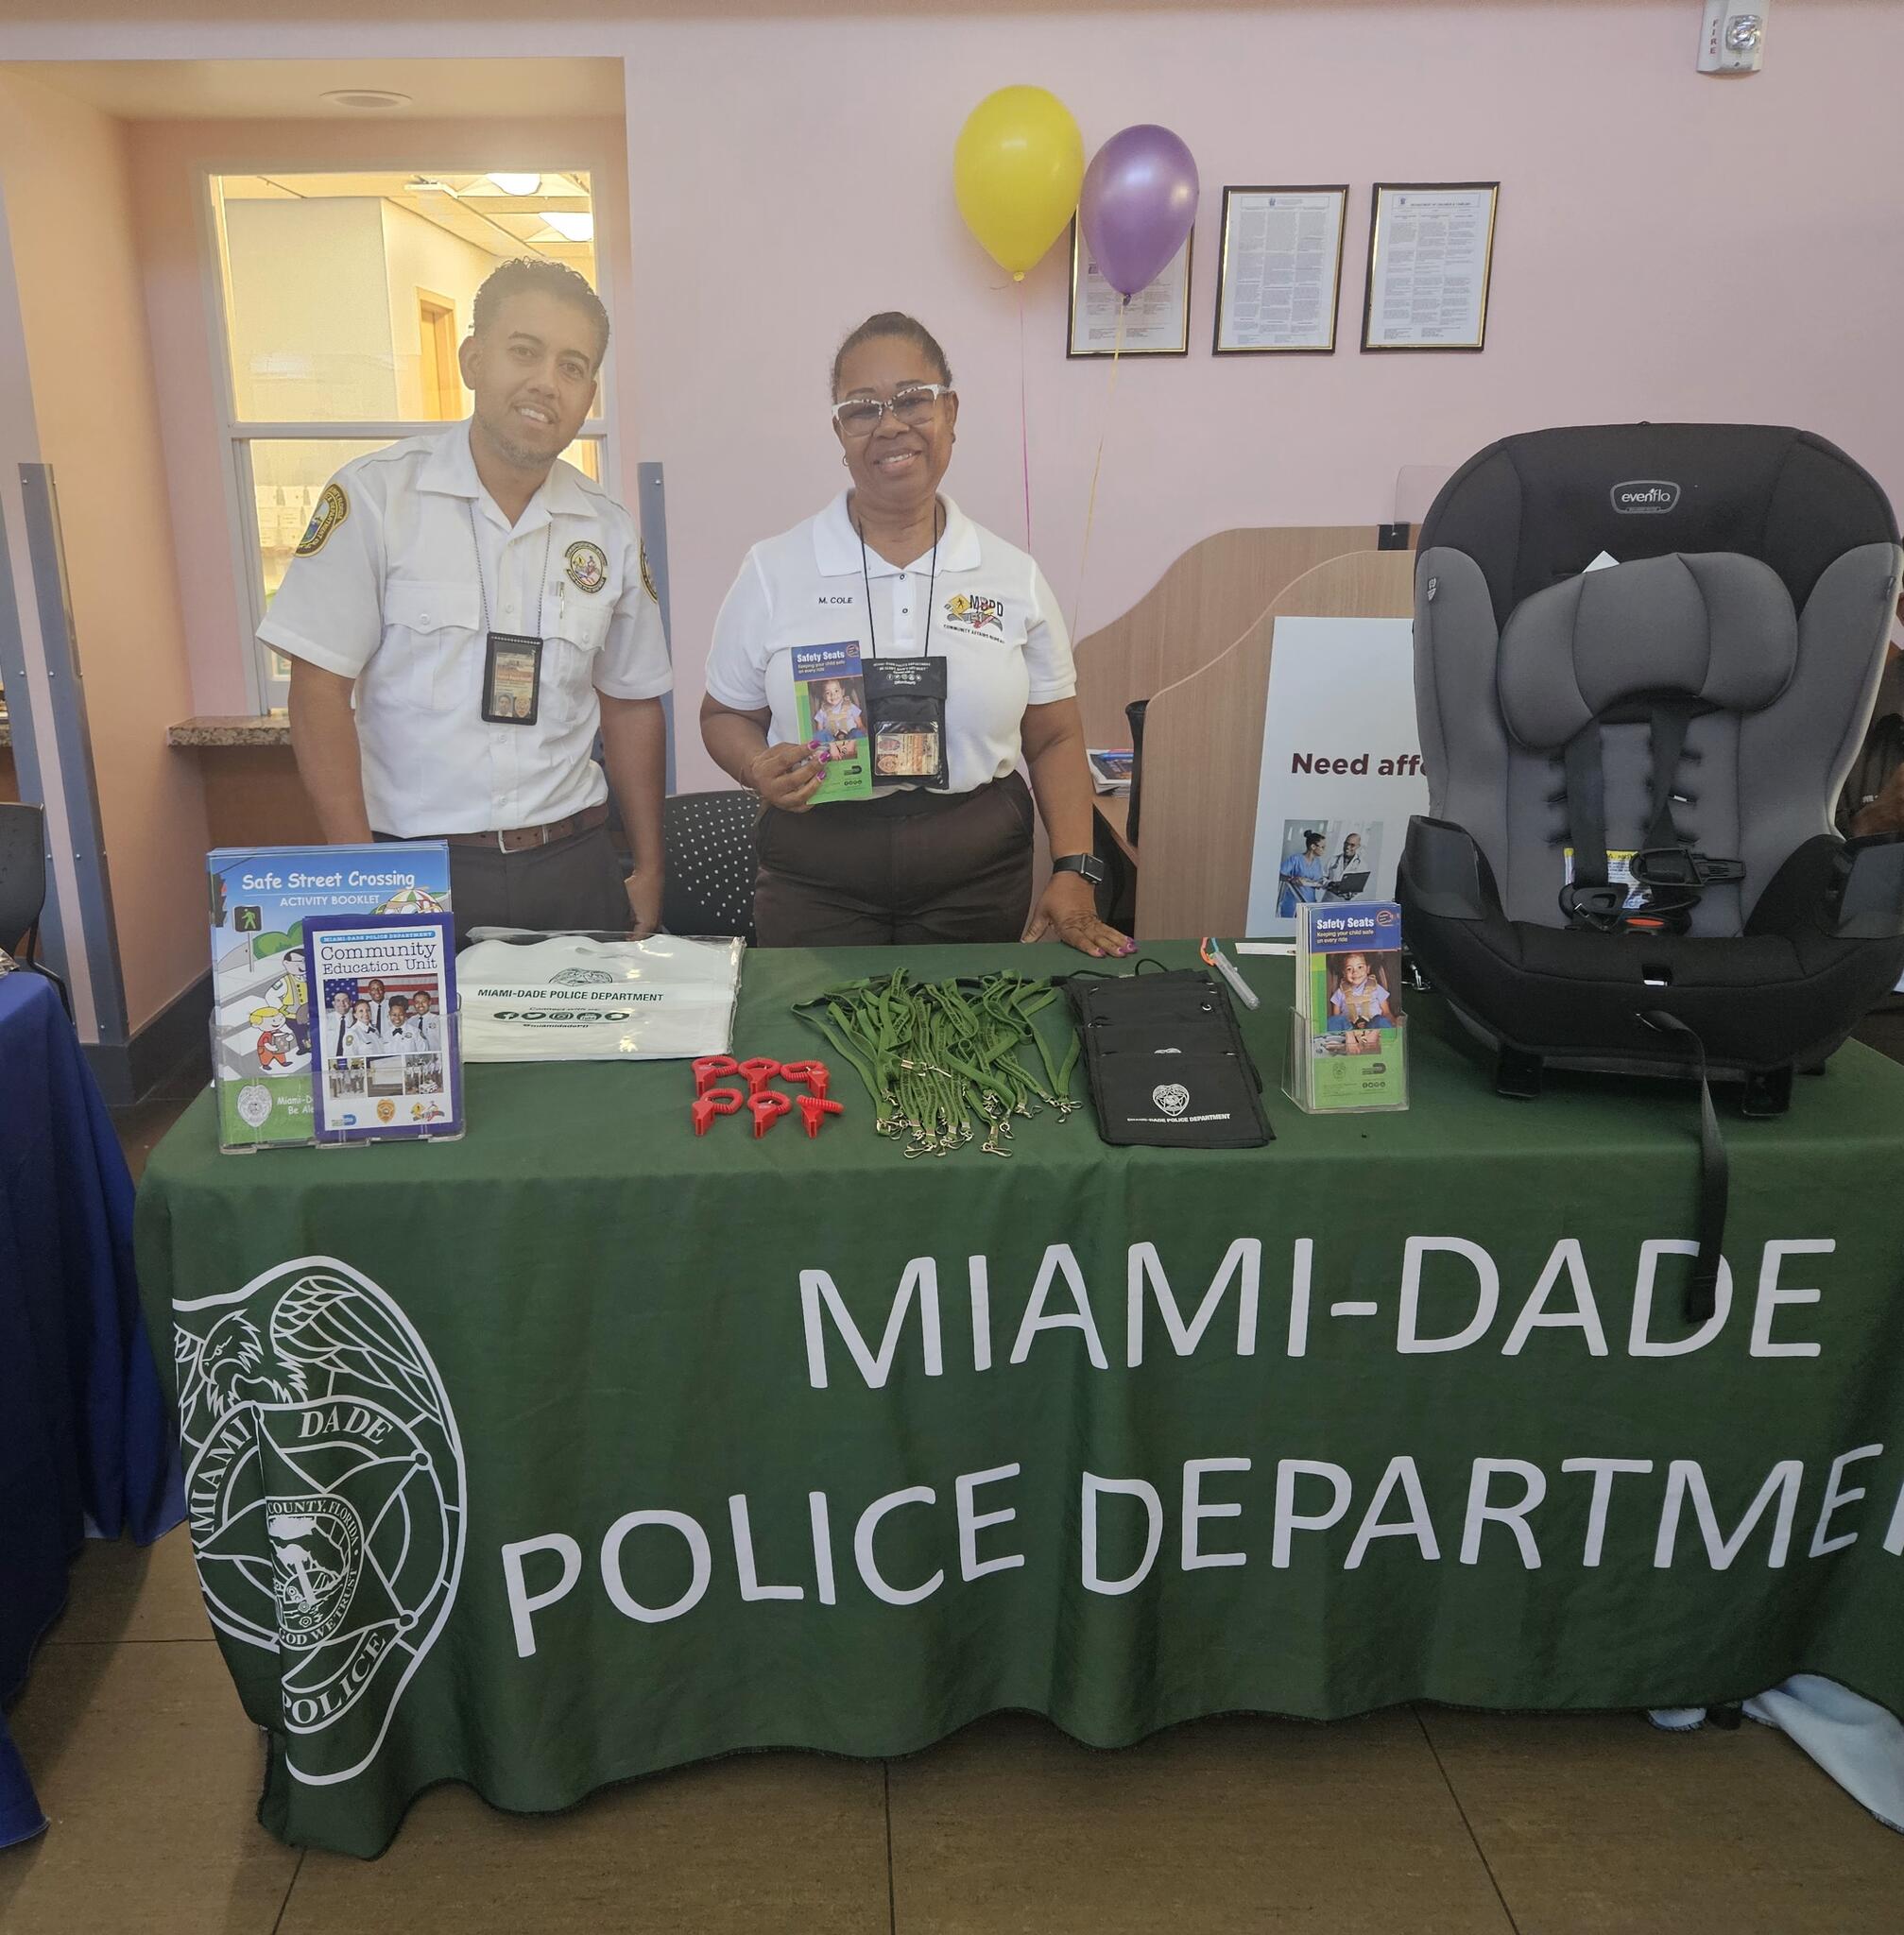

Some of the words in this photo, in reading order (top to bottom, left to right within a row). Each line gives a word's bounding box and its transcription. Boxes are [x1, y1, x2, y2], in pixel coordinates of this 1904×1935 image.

[1709, 18, 1719, 54] FIRE
[1621, 488, 1671, 503] evenflo
[831, 596, 853, 605] COLE
[797, 653, 821, 662] Safety
[822, 651, 845, 660] Seats
[1292, 753, 1369, 775] Need
[242, 872, 283, 890] Safe
[287, 872, 342, 888] Street
[348, 870, 416, 889] Crossing
[280, 896, 328, 907] ACTIVITY
[332, 895, 380, 905] BOOKLET
[1316, 918, 1346, 930] Safety
[1347, 917, 1375, 928] Seats
[321, 942, 437, 960] Community
[323, 961, 400, 975] Education
[405, 958, 437, 971] Unit
[477, 989, 547, 999] MIAMI-DADE
[549, 990, 588, 1001] POLICE
[591, 992, 664, 1002] DEPARTMENT
[287, 1105, 299, 1115] Be
[1190, 1113, 1230, 1122] DEPARTMENT
[799, 1236, 1835, 1388] MIAMI-DADE
[298, 1405, 393, 1445] DADE
[190, 1416, 252, 1533] MIAMI
[331, 1501, 359, 1547] FLORIDA
[502, 1463, 1025, 1657] POLICE
[310, 1618, 335, 1640] WE
[334, 1568, 357, 1619] TRUST
[283, 1633, 386, 1723] POLICE
